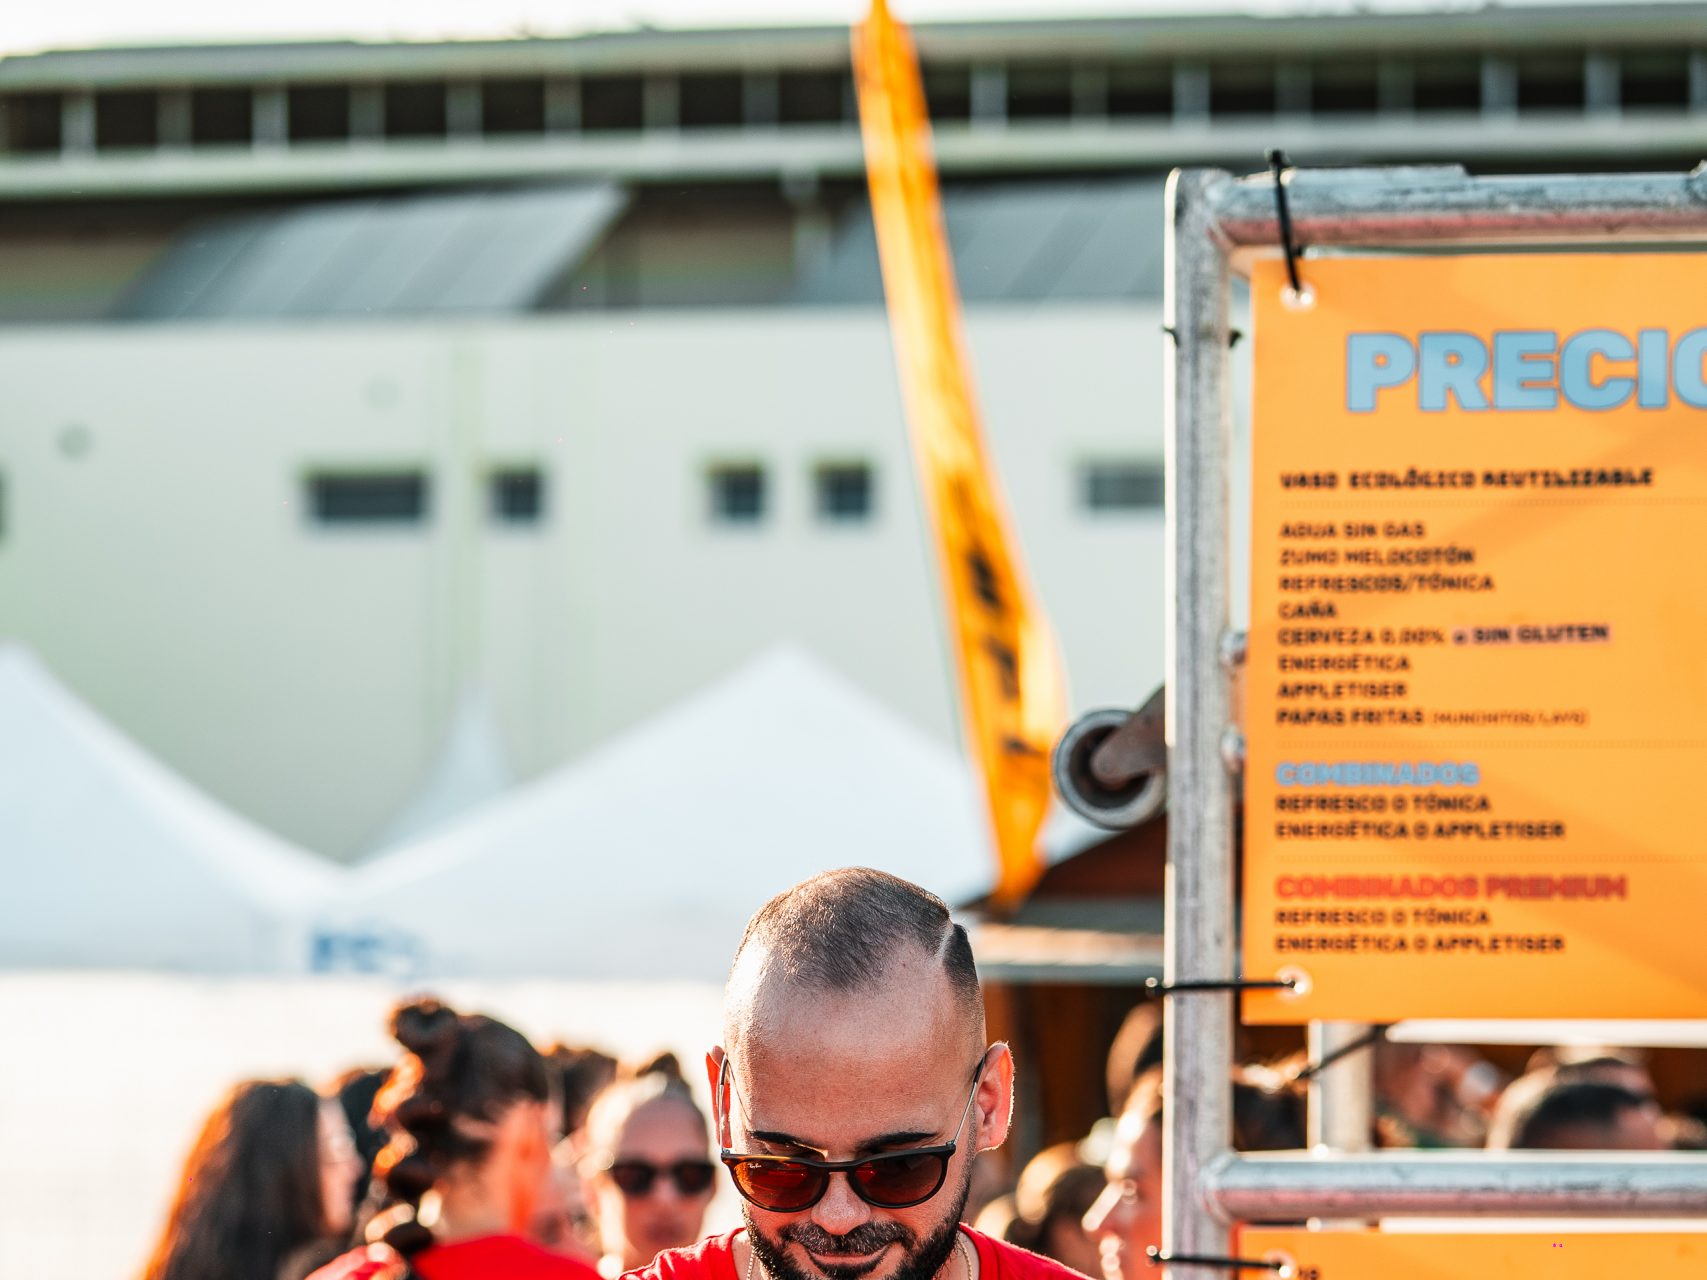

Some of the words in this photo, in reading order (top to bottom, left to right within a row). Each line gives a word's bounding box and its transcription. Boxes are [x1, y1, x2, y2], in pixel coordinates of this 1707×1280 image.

[1280, 471, 1339, 489] VASO
[1348, 467, 1477, 489] ECOLÓGICO
[1481, 467, 1654, 488] REUTILIZABLE
[1279, 522, 1338, 539] AGUA
[1343, 522, 1378, 539] SIN
[1382, 522, 1426, 538] GAS
[1279, 549, 1340, 566] ZUMO
[1344, 545, 1476, 566] MELOCOTÓN
[1278, 600, 1338, 620] CAÑA
[1278, 628, 1375, 647] CERVEZA
[1473, 627, 1511, 643] SIN
[1516, 624, 1609, 643] GLUTEN
[1277, 653, 1411, 673] ENERGÉTICA
[1277, 681, 1407, 699] APPLETISER
[1276, 708, 1346, 726] PAPAS
[1350, 708, 1424, 725] FRITAS
[1276, 763, 1480, 786] COMBINADOS
[1275, 795, 1388, 812] REFRESCO
[1391, 795, 1408, 812] O
[1412, 793, 1492, 812] TÓNICA
[1275, 820, 1409, 839] ENERGÉTICA
[1413, 821, 1429, 839] O
[1432, 821, 1566, 839] APPLETISER
[1275, 876, 1478, 899] COMBINADOS
[1484, 876, 1628, 899] PREMIUM
[1274, 909, 1388, 926] REFRESCO
[1391, 909, 1408, 926] O
[1412, 906, 1491, 926] TÓNICA
[1274, 933, 1409, 952] ENERGÉTICA
[1412, 935, 1429, 952] O
[1432, 935, 1566, 953] APPLETISER
